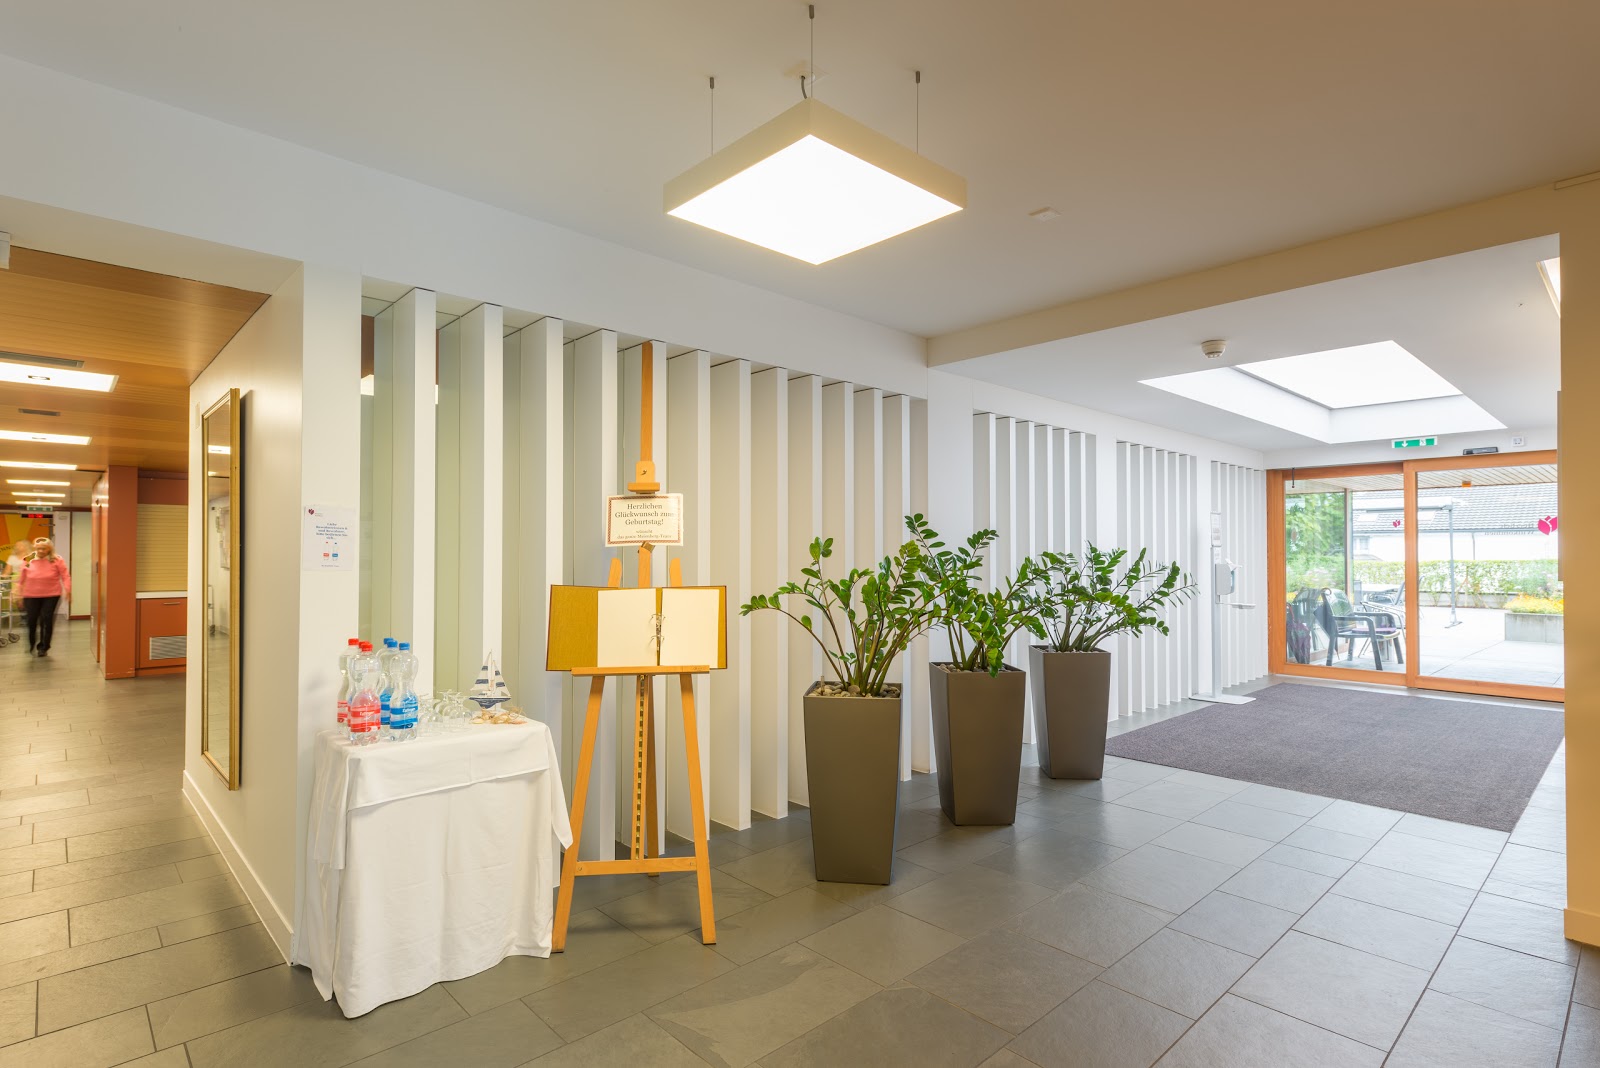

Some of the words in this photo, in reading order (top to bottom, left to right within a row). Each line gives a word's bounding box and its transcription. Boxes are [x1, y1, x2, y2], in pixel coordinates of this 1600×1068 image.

[627, 502, 663, 510] Herzlichen
[614, 510, 659, 518] Glückwunsch
[625, 518, 664, 526] Geburtstag!
